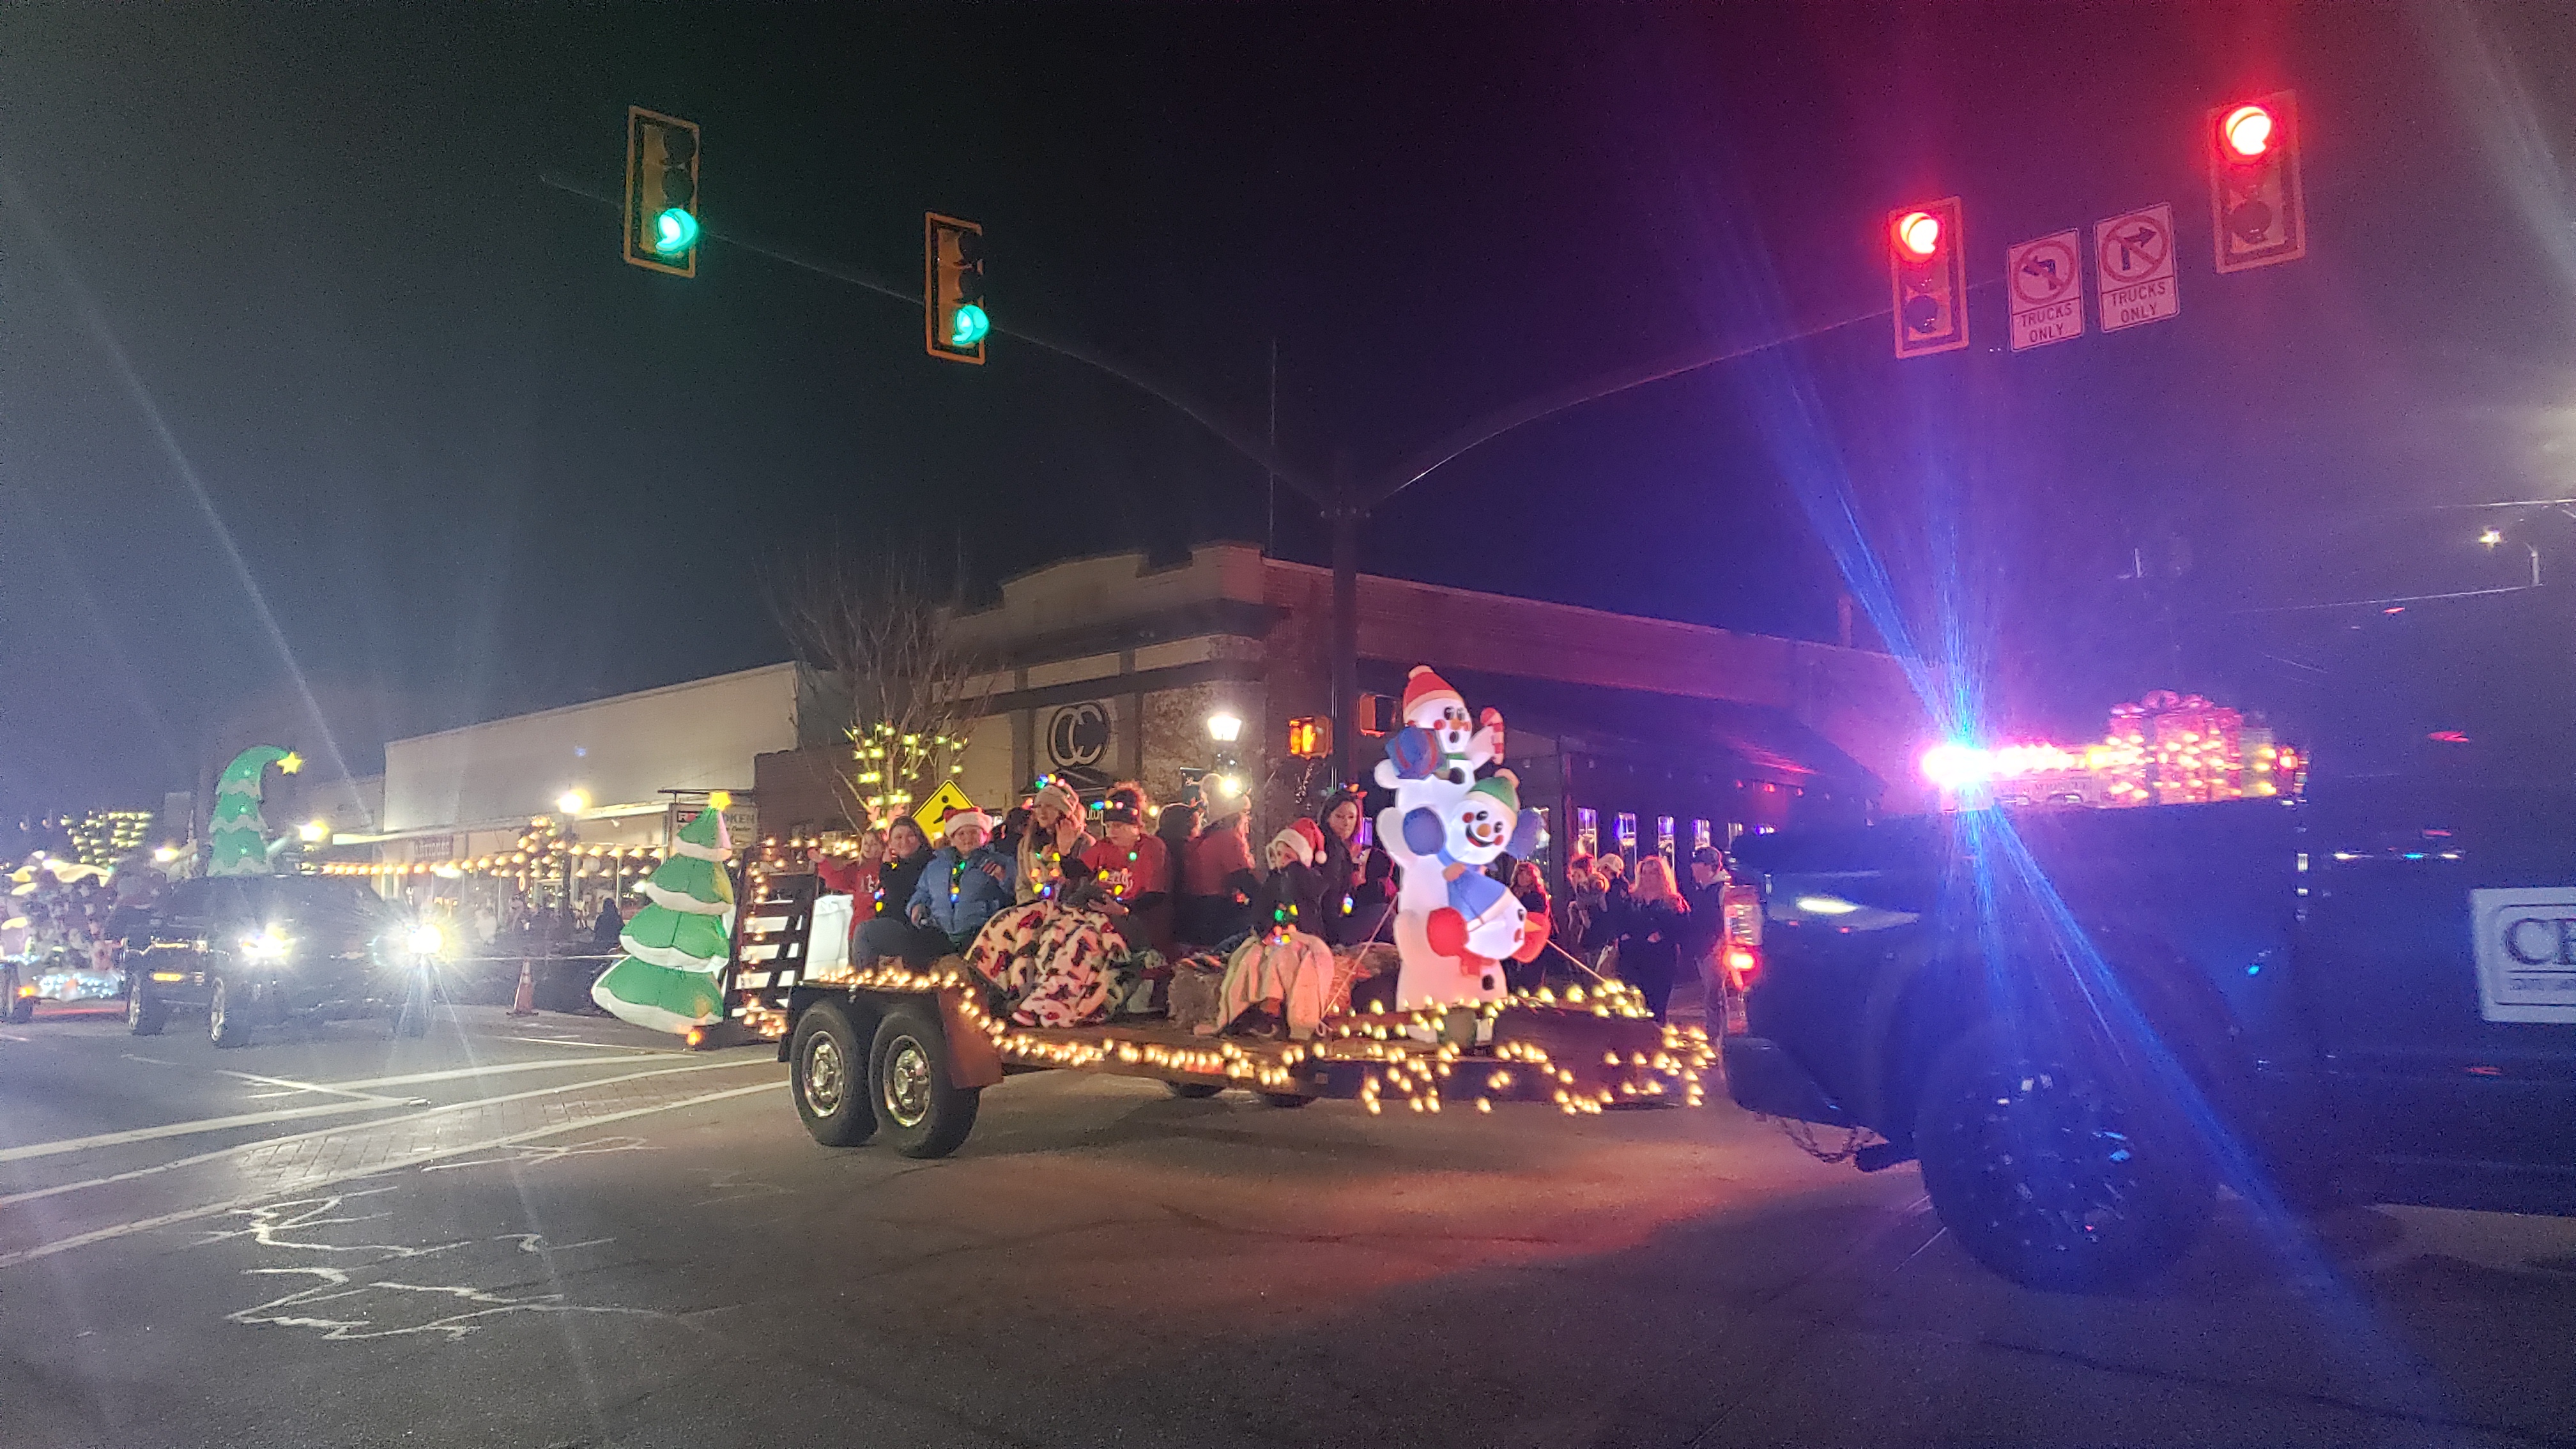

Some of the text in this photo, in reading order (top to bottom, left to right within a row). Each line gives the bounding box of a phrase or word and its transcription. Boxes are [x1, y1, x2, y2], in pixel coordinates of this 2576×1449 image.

[2111, 281, 2166, 307] TRUCKS
[2021, 302, 2073, 327] TRUCKS
[2120, 304, 2158, 323] ONLY
[2029, 323, 2064, 343] ONLY
